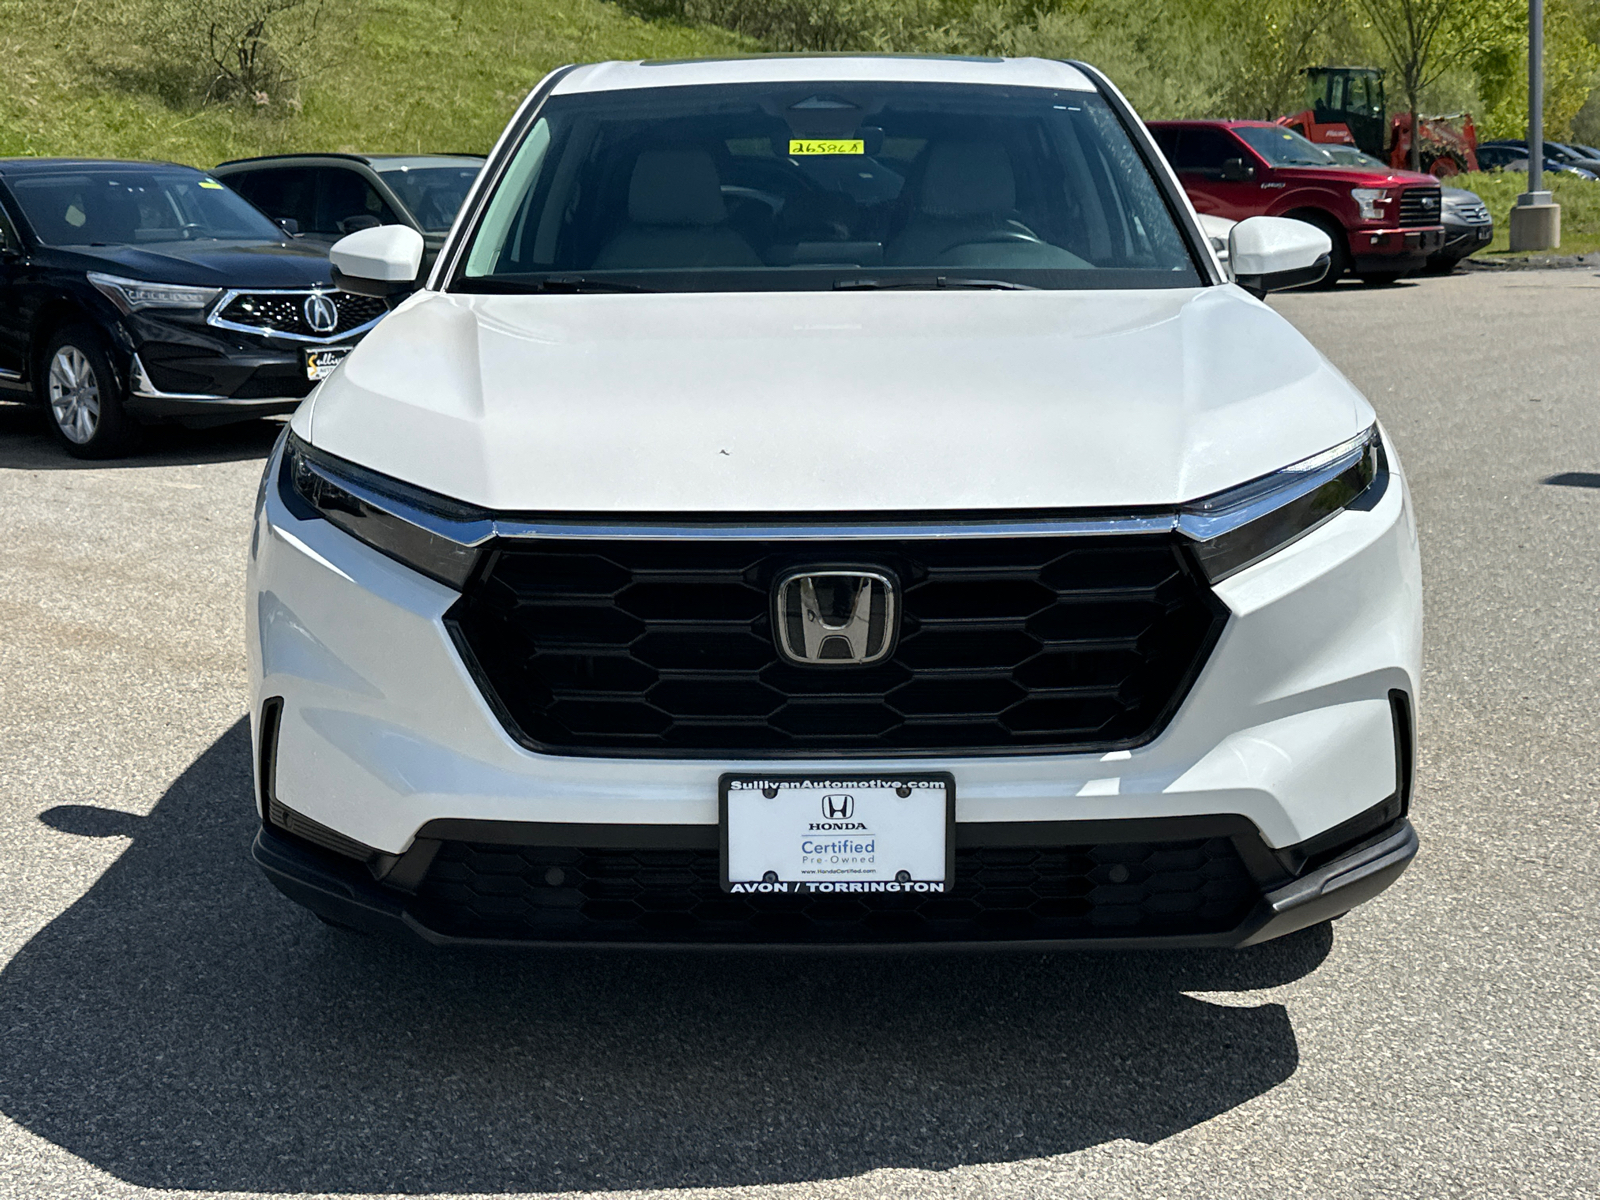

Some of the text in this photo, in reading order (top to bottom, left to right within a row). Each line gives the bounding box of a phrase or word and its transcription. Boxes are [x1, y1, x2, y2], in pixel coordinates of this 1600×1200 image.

[730, 780, 945, 790] SullivanAutomotive.com
[808, 822, 868, 831] HONDA
[801, 839, 875, 854] Certified
[802, 855, 875, 864] Pre-Owned
[730, 882, 788, 893] AVON
[806, 882, 945, 893] TORRINGTON
